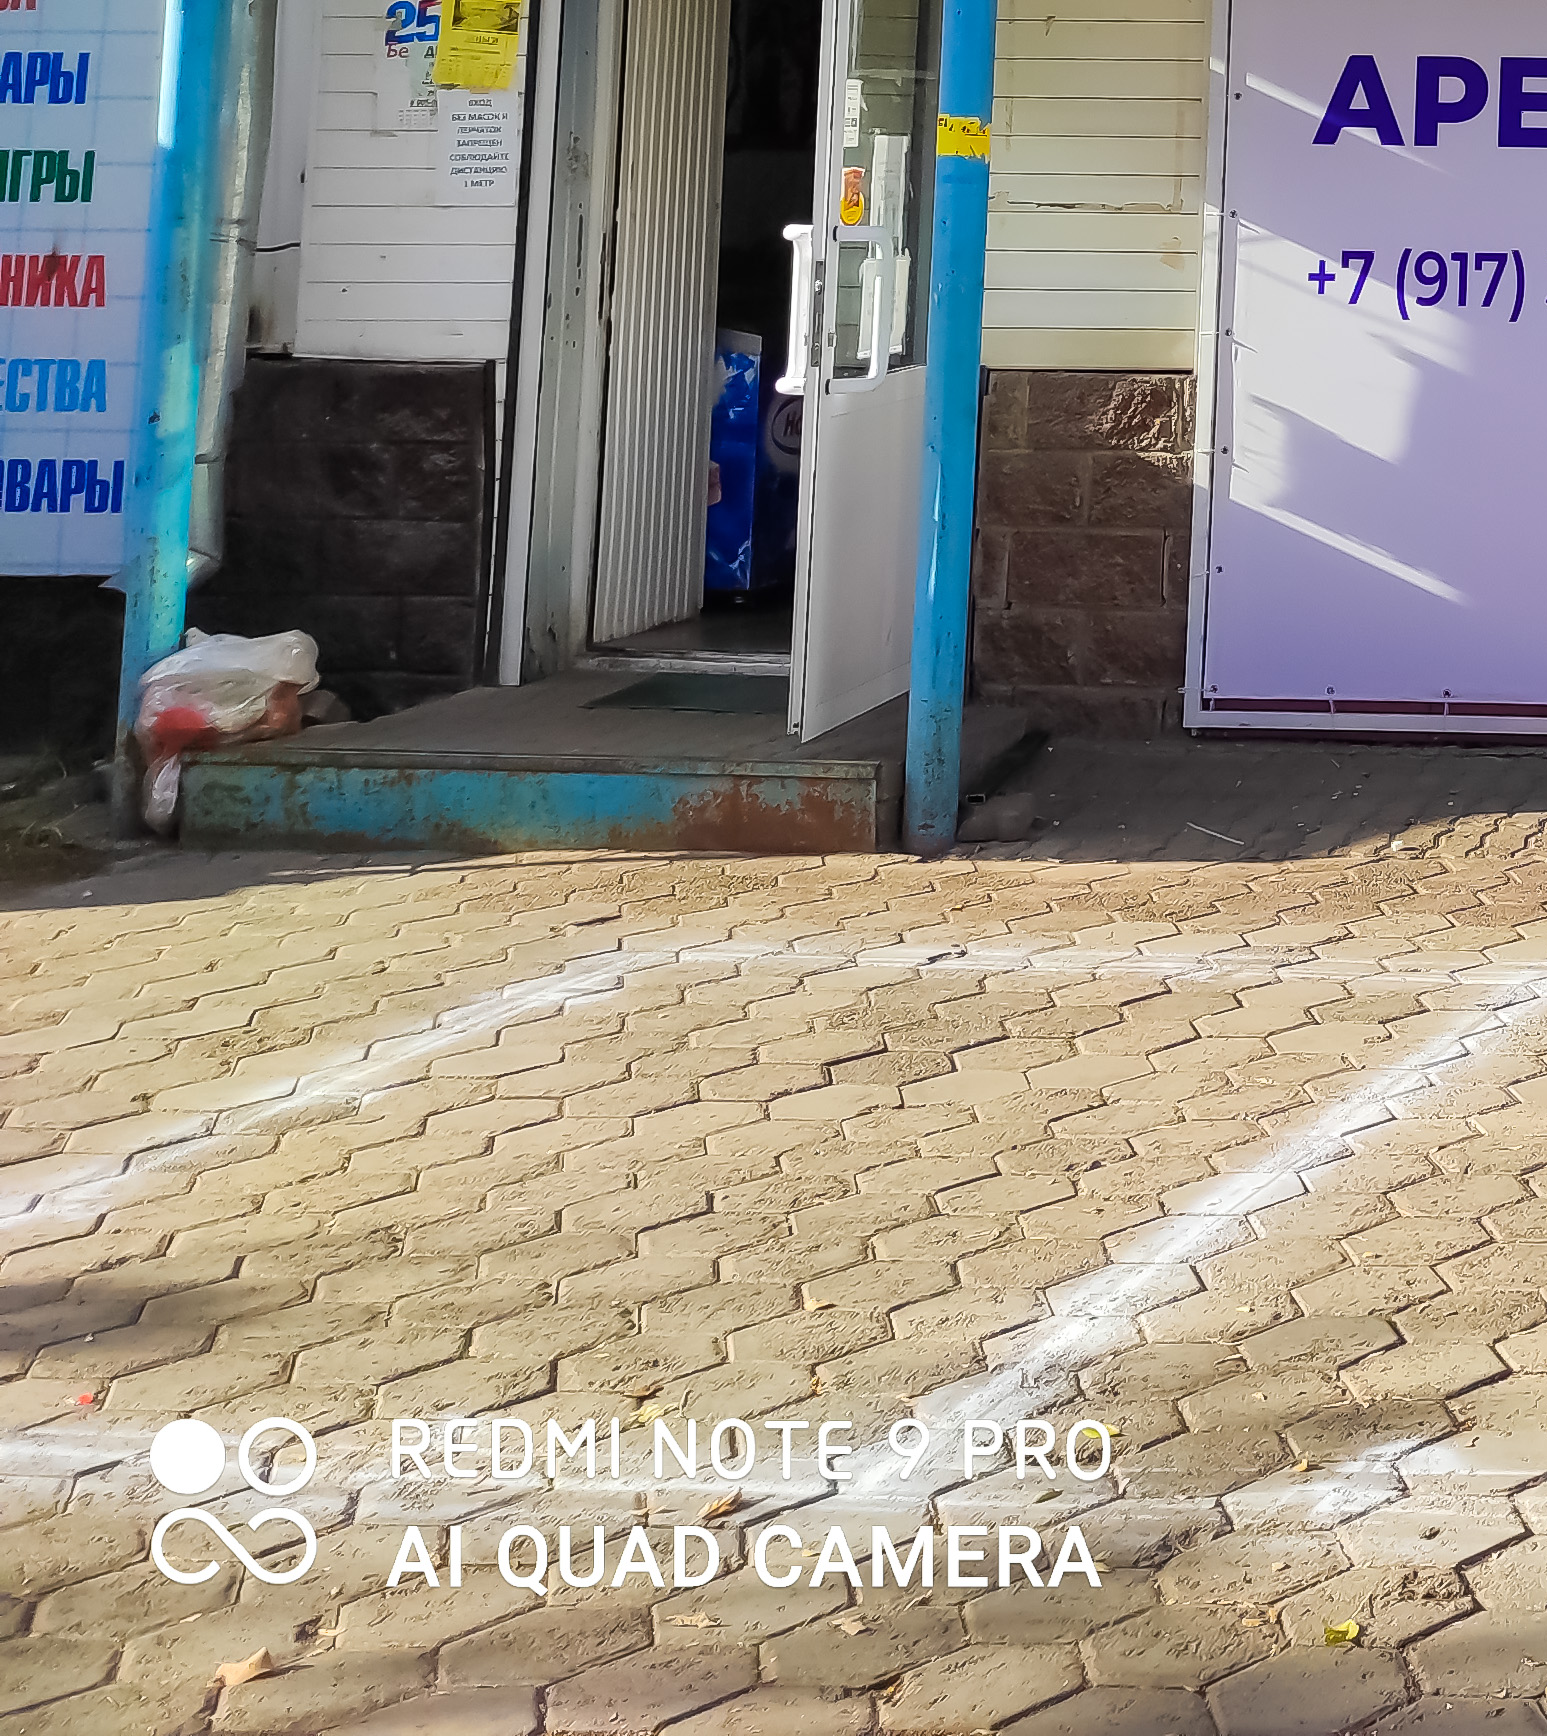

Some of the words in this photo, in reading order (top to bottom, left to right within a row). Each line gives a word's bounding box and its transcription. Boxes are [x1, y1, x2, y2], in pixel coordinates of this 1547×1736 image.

[1308, 249, 1376, 304] +7
[1395, 247, 1525, 323] (917)
[0, 358, 107, 412] СТВА
[0, 458, 125, 513] ВАРЫ
